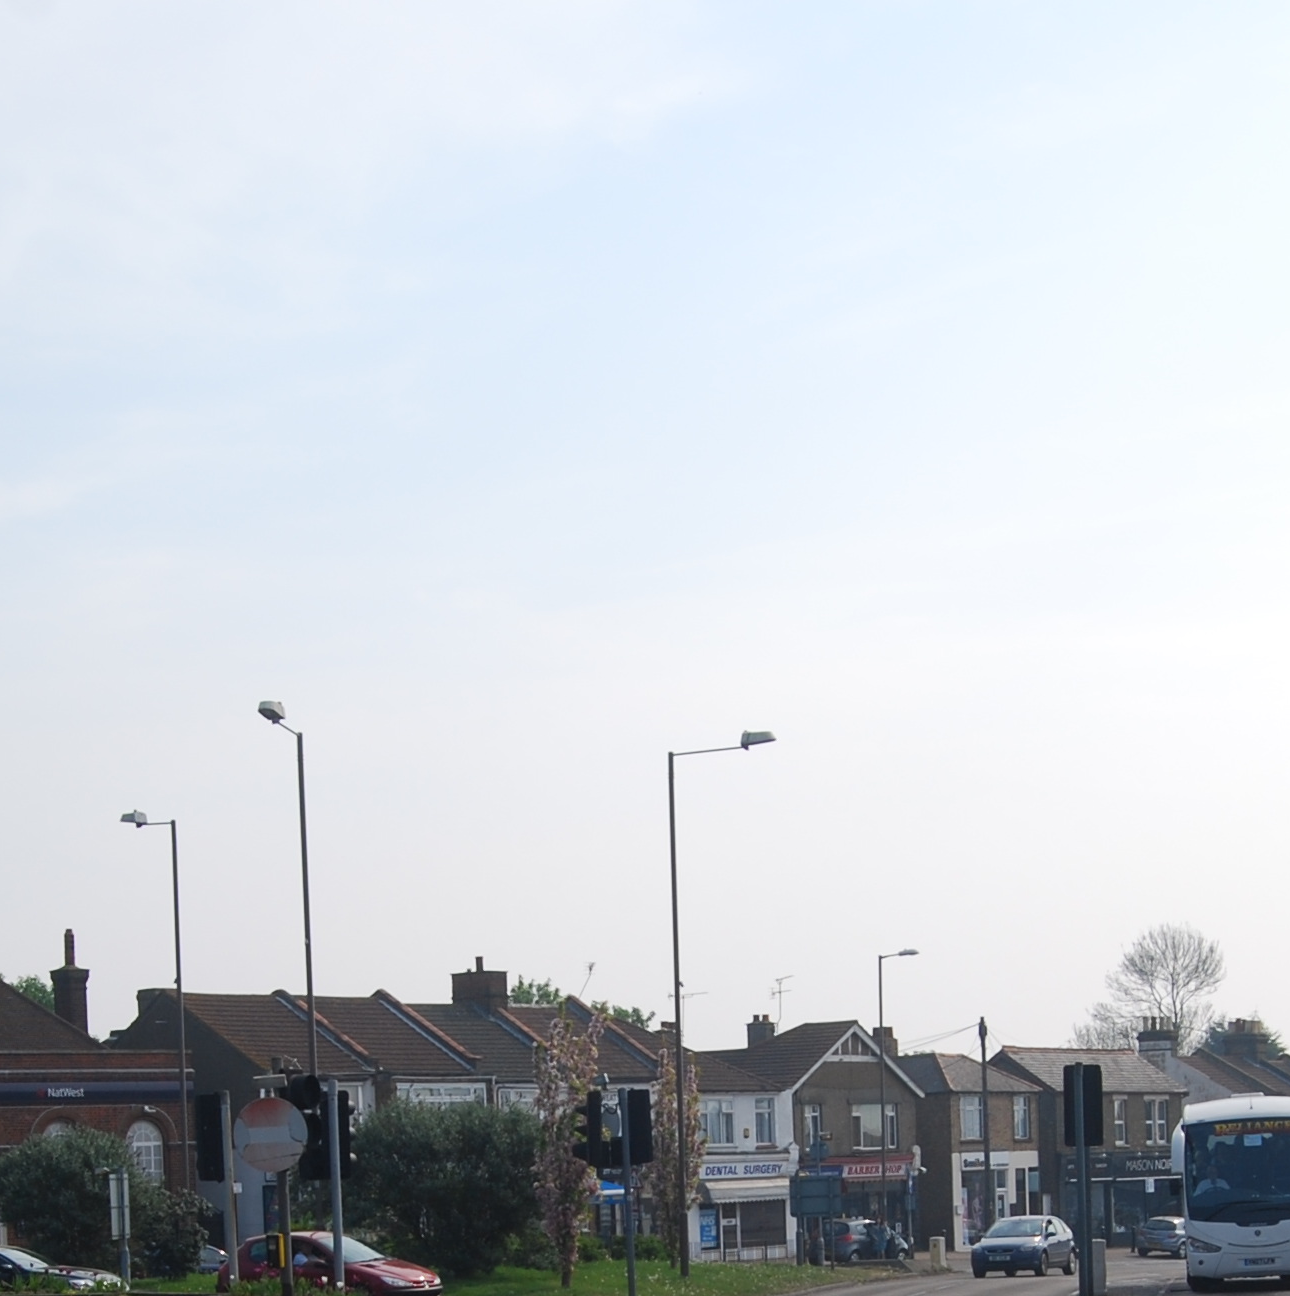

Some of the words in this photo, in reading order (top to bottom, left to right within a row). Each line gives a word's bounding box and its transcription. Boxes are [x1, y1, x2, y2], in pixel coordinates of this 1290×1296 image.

[47, 1087, 85, 1098] NatWest
[705, 1166, 738, 1176] DENTAL
[743, 1164, 783, 1175] SURGERY
[847, 1165, 880, 1175] BARBER
[1125, 1159, 1153, 1171] MAISON
